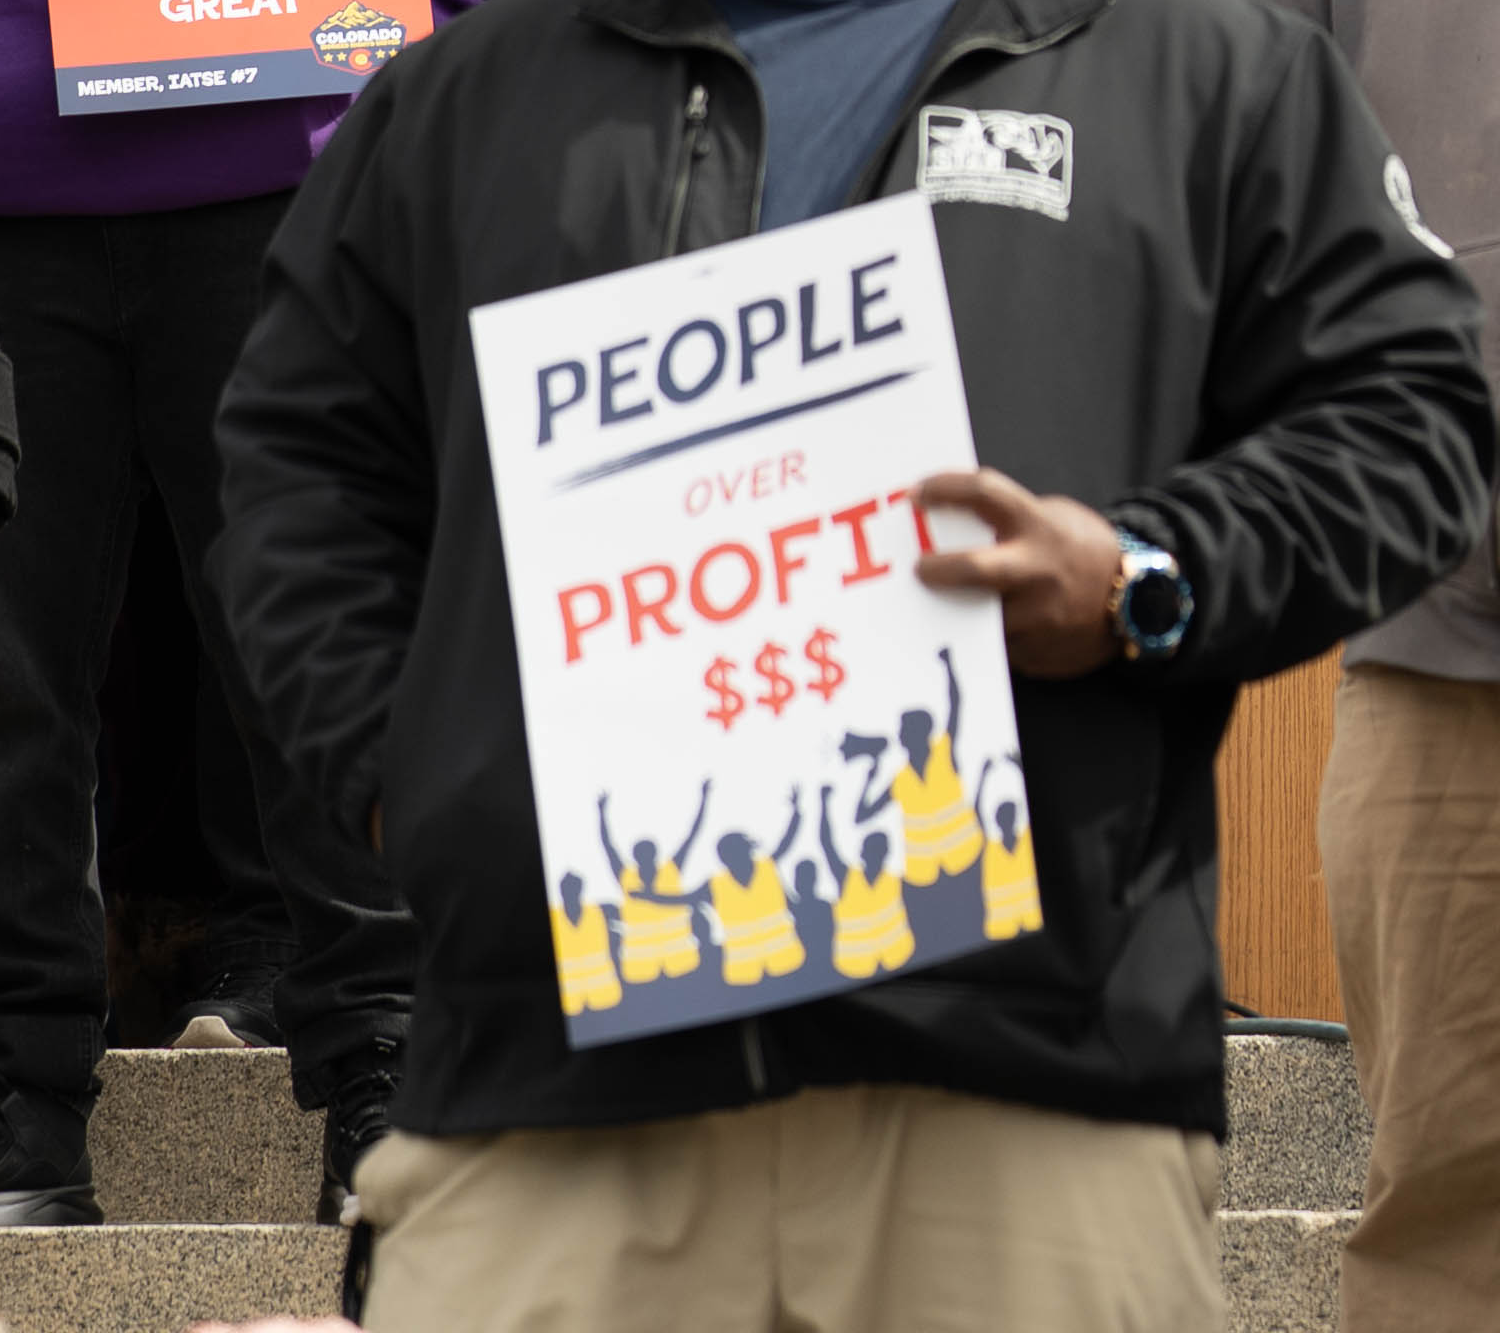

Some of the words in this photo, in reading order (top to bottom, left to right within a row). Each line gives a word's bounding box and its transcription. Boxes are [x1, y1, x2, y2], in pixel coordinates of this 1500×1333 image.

[315, 27, 402, 45] COLORADO
[77, 71, 164, 97] MEMBER,
[168, 67, 227, 92] IATSE
[231, 65, 258, 86] #7
[536, 255, 904, 445] PEOPLE
[683, 451, 805, 517] OVER
[558, 490, 937, 664] PROFIT
[705, 627, 848, 729] $$$
